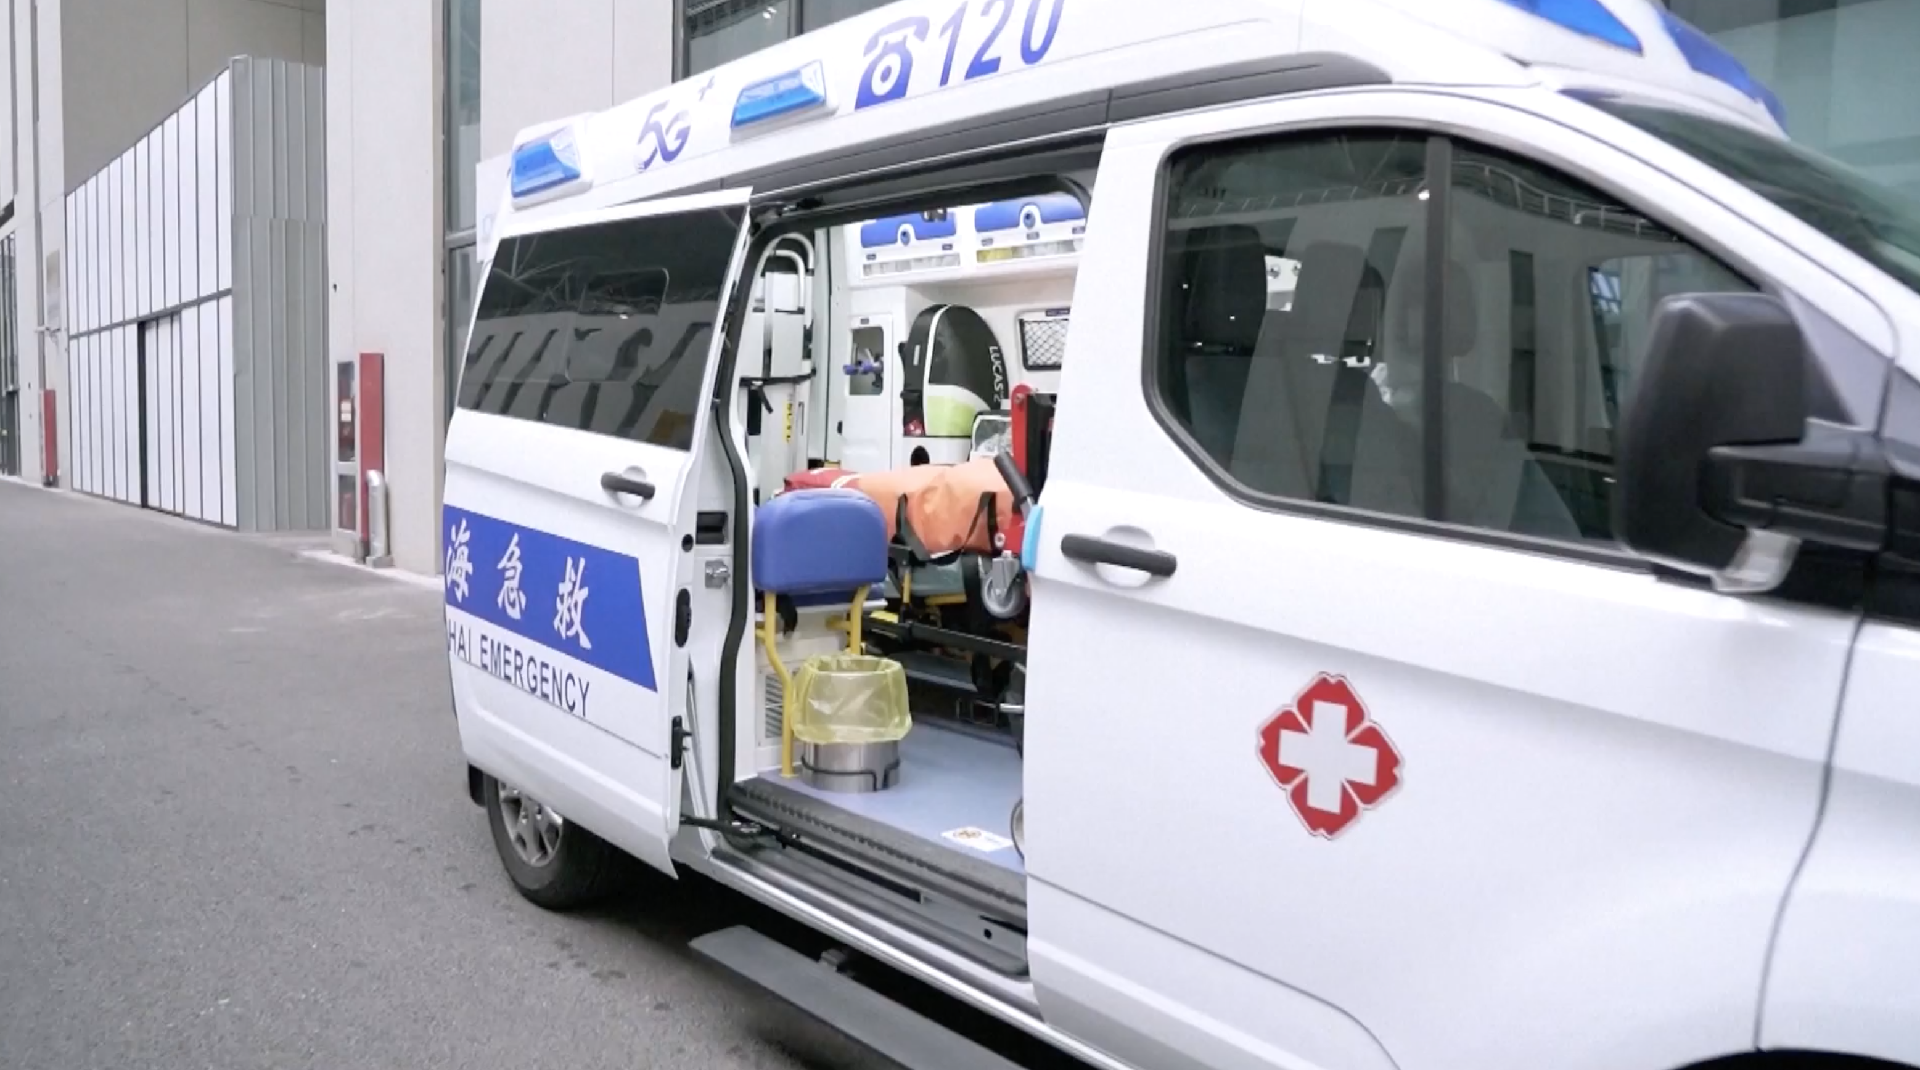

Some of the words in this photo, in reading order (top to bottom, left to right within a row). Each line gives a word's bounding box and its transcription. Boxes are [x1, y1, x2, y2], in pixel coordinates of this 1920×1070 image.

[939, 0, 1065, 87] 120
[989, 345, 1004, 392] LUCAS
[446, 517, 592, 650] 海急救
[480, 634, 590, 716] EMERGENCY
